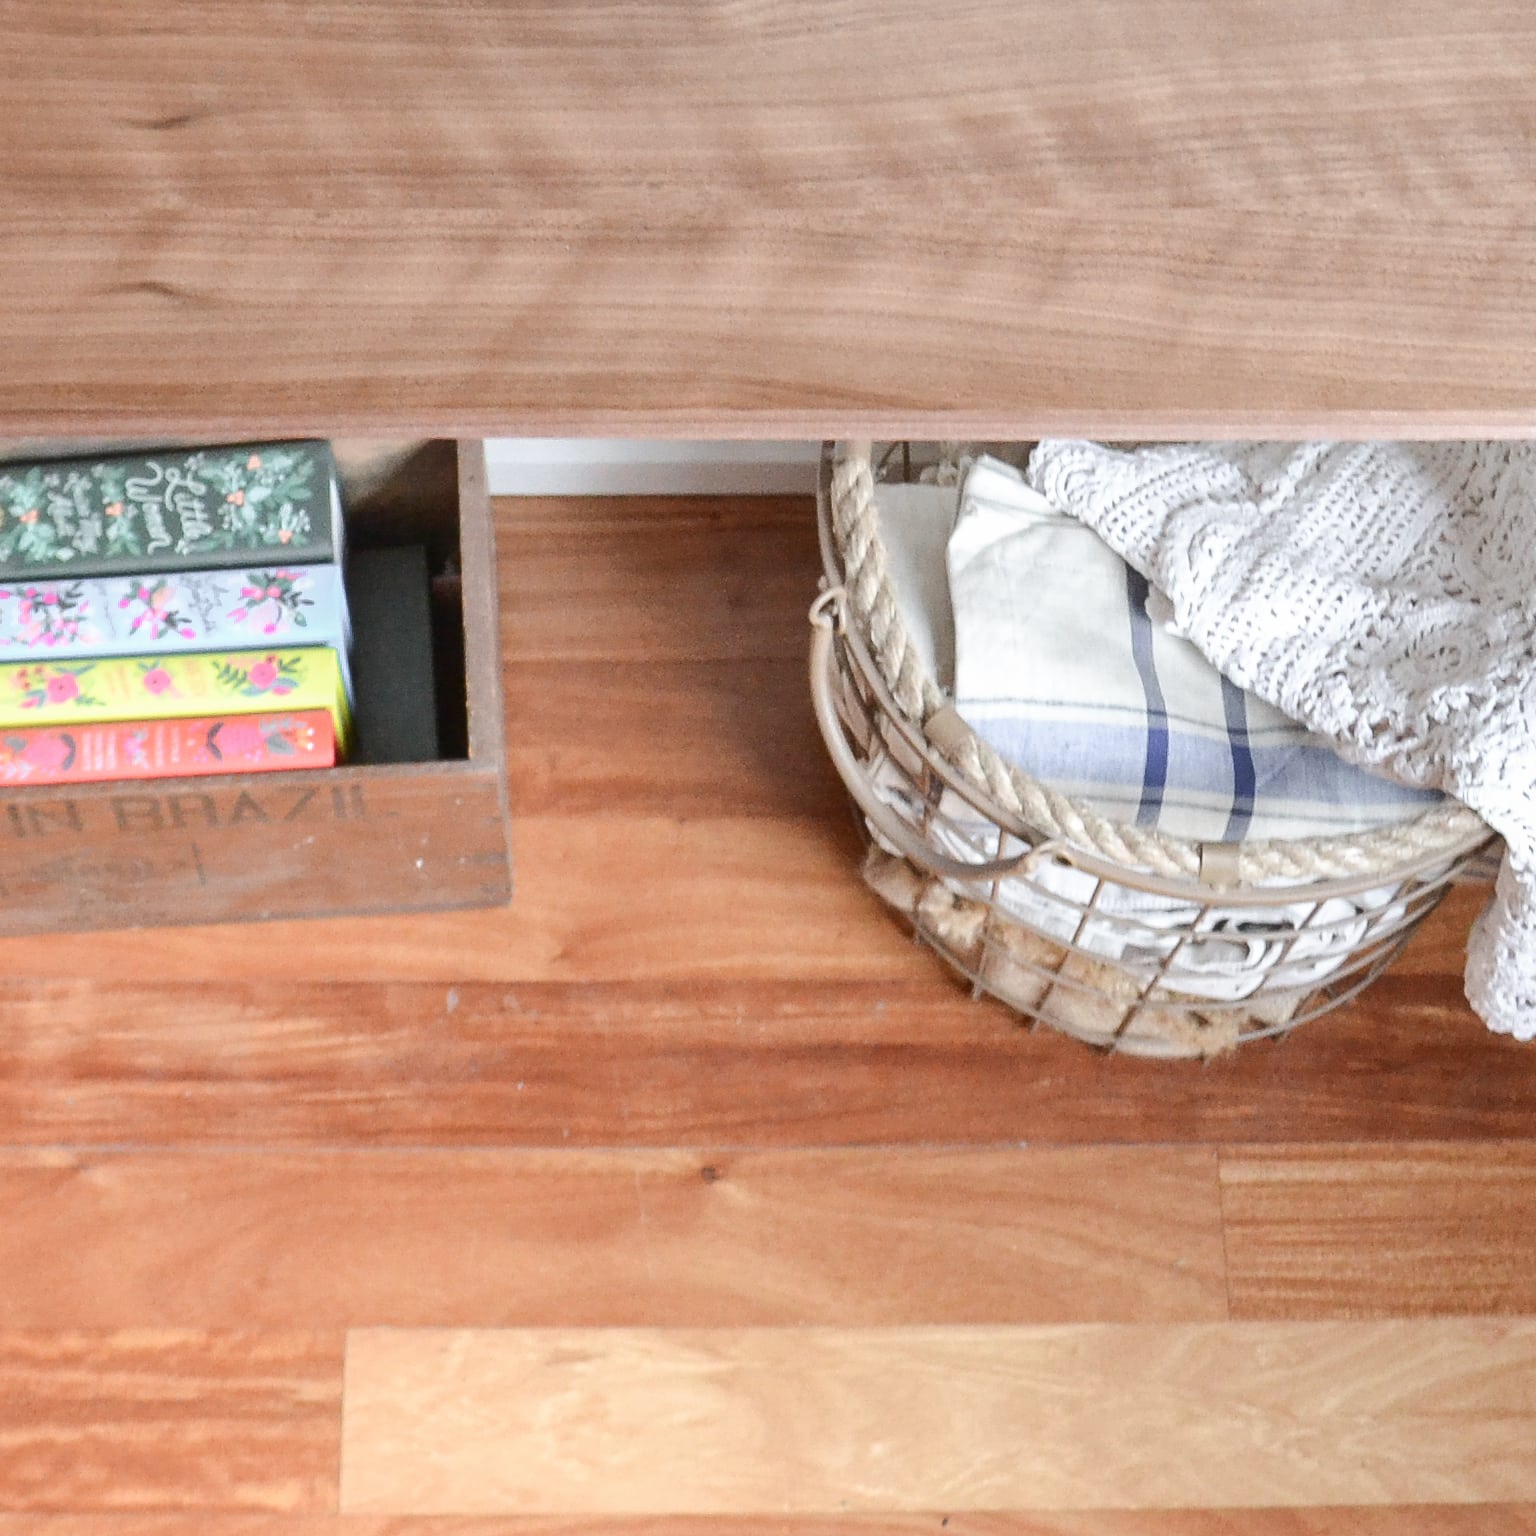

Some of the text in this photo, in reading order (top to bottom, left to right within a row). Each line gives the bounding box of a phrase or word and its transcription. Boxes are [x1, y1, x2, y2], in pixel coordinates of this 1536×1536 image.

[165, 467, 212, 541] Little
[7, 799, 84, 839] IN
[110, 783, 400, 832] BRAZIL
